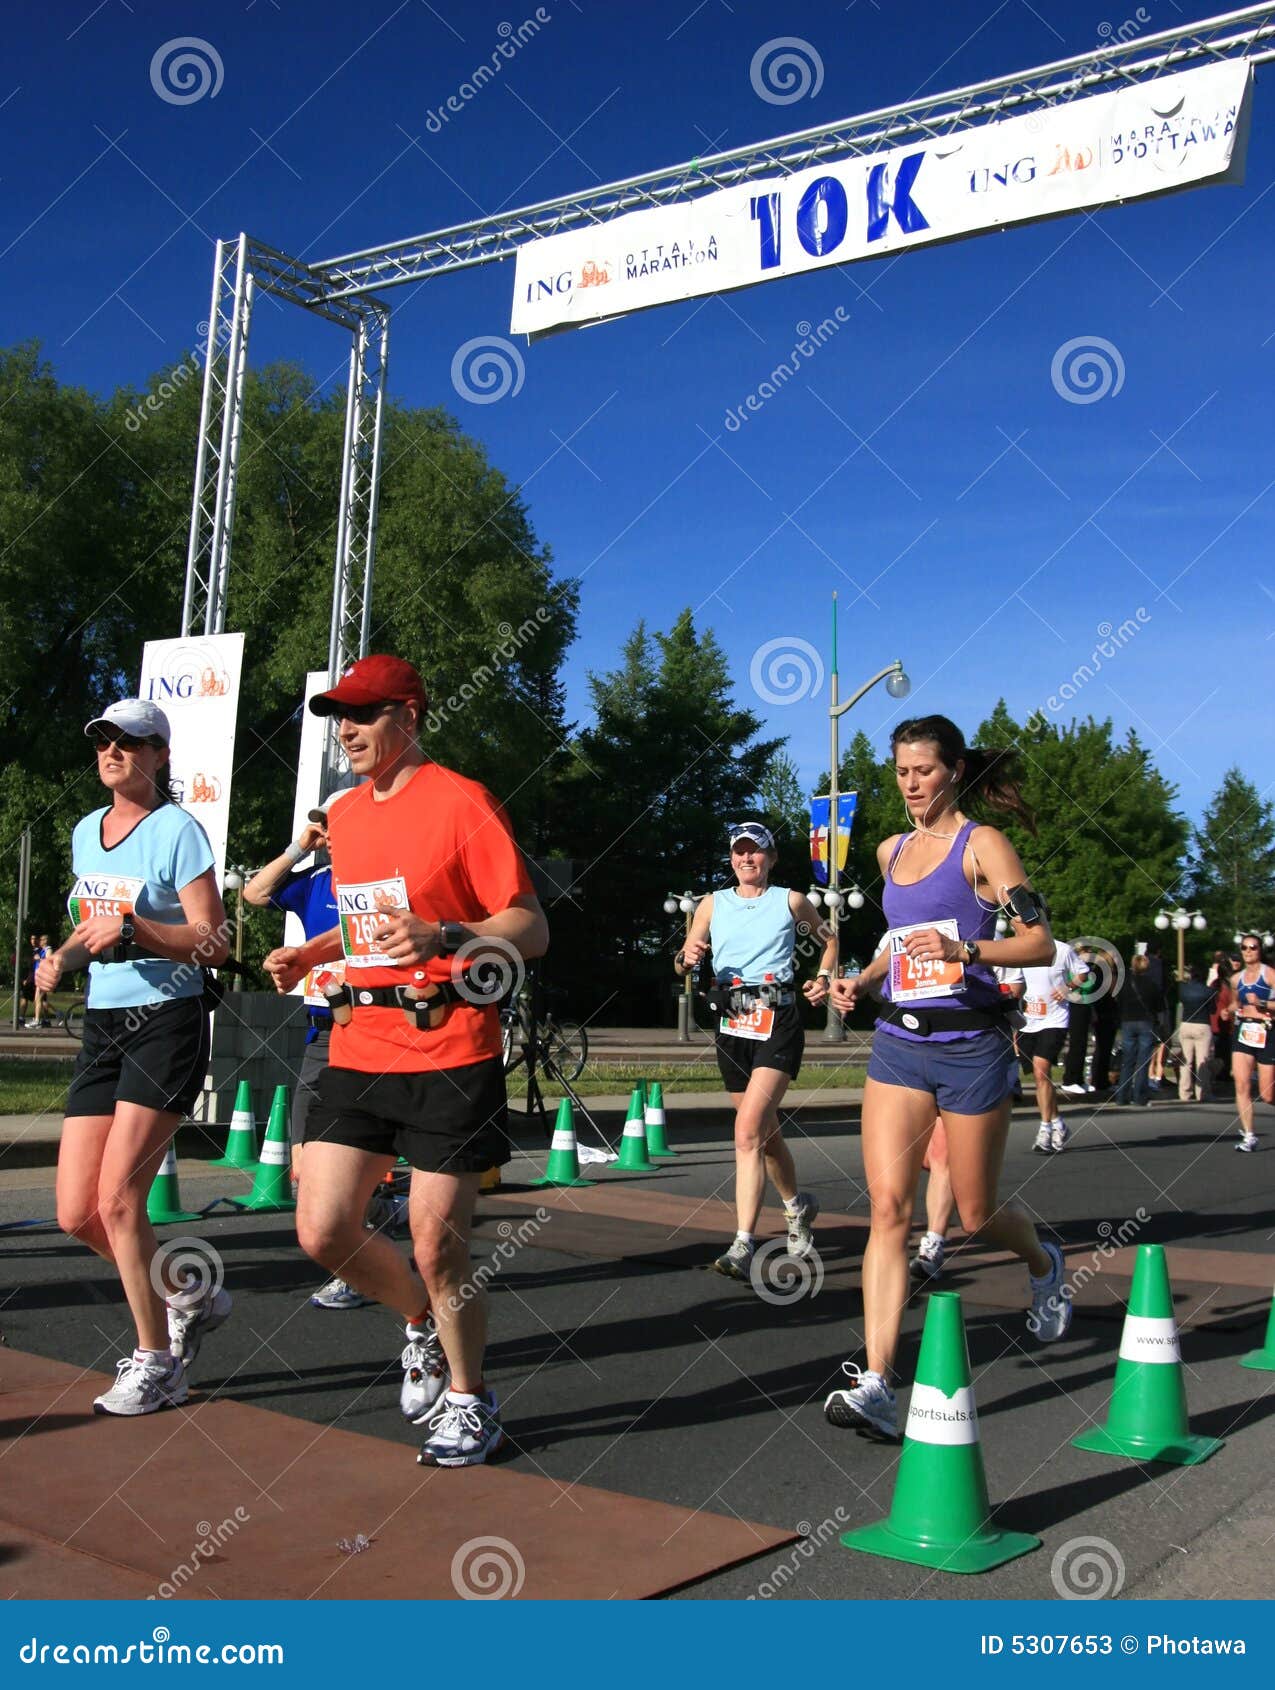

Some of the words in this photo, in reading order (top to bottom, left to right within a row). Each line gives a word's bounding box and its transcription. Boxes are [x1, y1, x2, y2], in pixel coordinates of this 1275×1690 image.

[1111, 105, 1236, 145] MARAN
[750, 151, 930, 270] 10K
[527, 271, 572, 303] ING
[148, 675, 193, 700] ING
[72, 881, 109, 897] ING
[339, 893, 368, 911] ING
